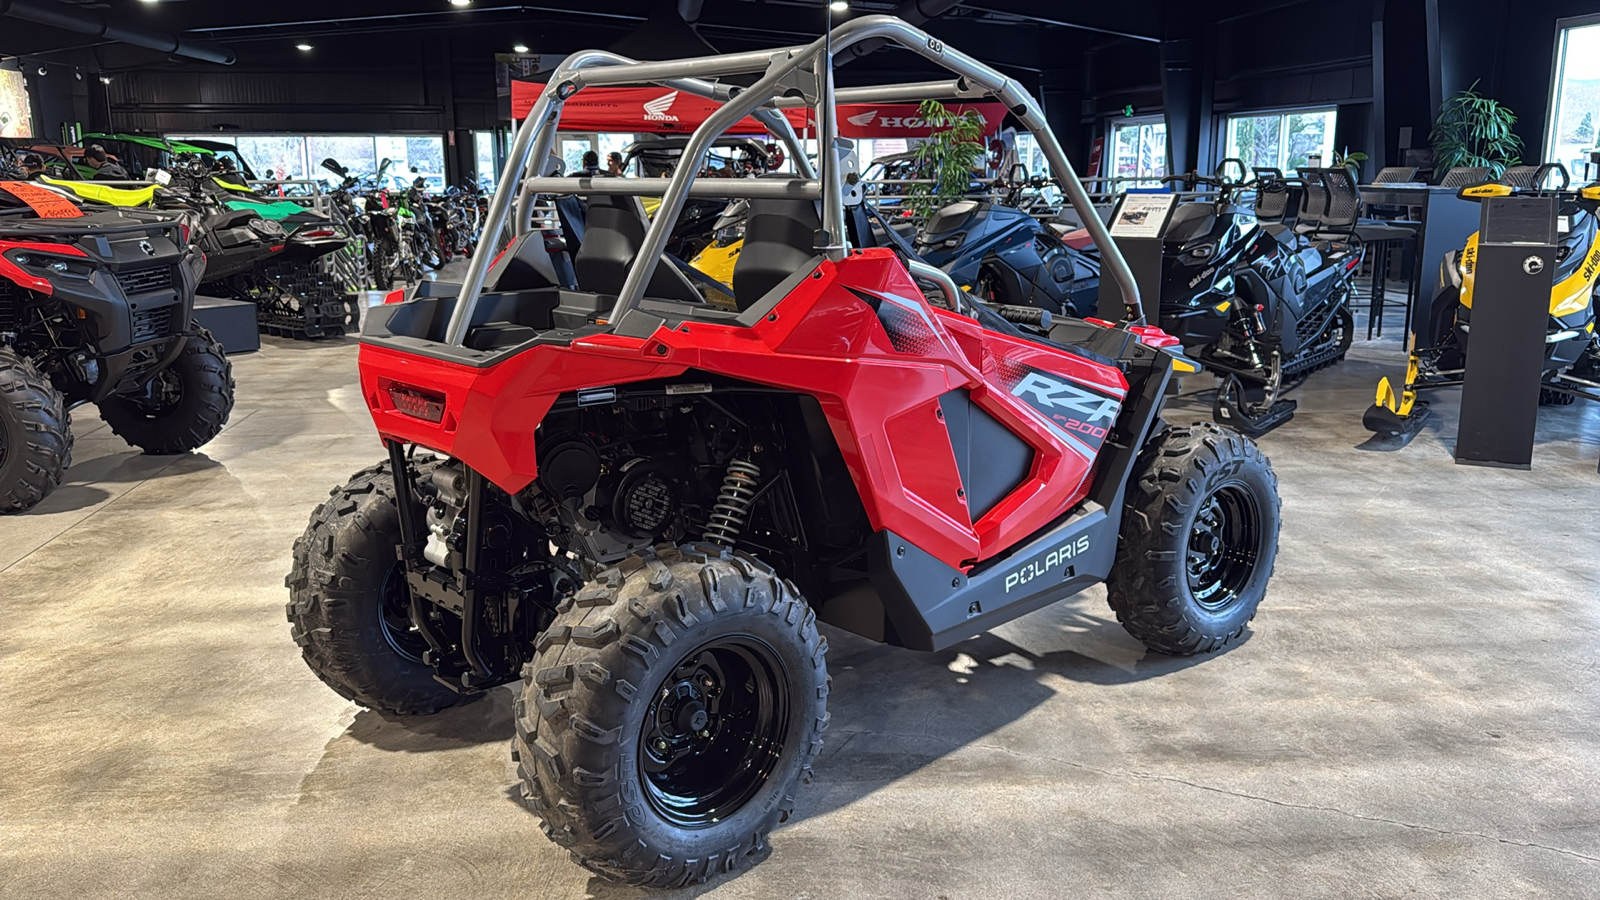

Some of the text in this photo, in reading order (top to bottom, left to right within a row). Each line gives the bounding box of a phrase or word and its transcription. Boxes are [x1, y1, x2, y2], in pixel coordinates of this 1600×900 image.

[643, 114, 680, 122] HONDA
[1465, 247, 1475, 275] ski-doo
[1188, 266, 1215, 289] ski-doo
[1064, 418, 1108, 438] 200
[1205, 459, 1246, 493] CST
[1005, 534, 1090, 594] POLARIS
[619, 752, 647, 827] CST
